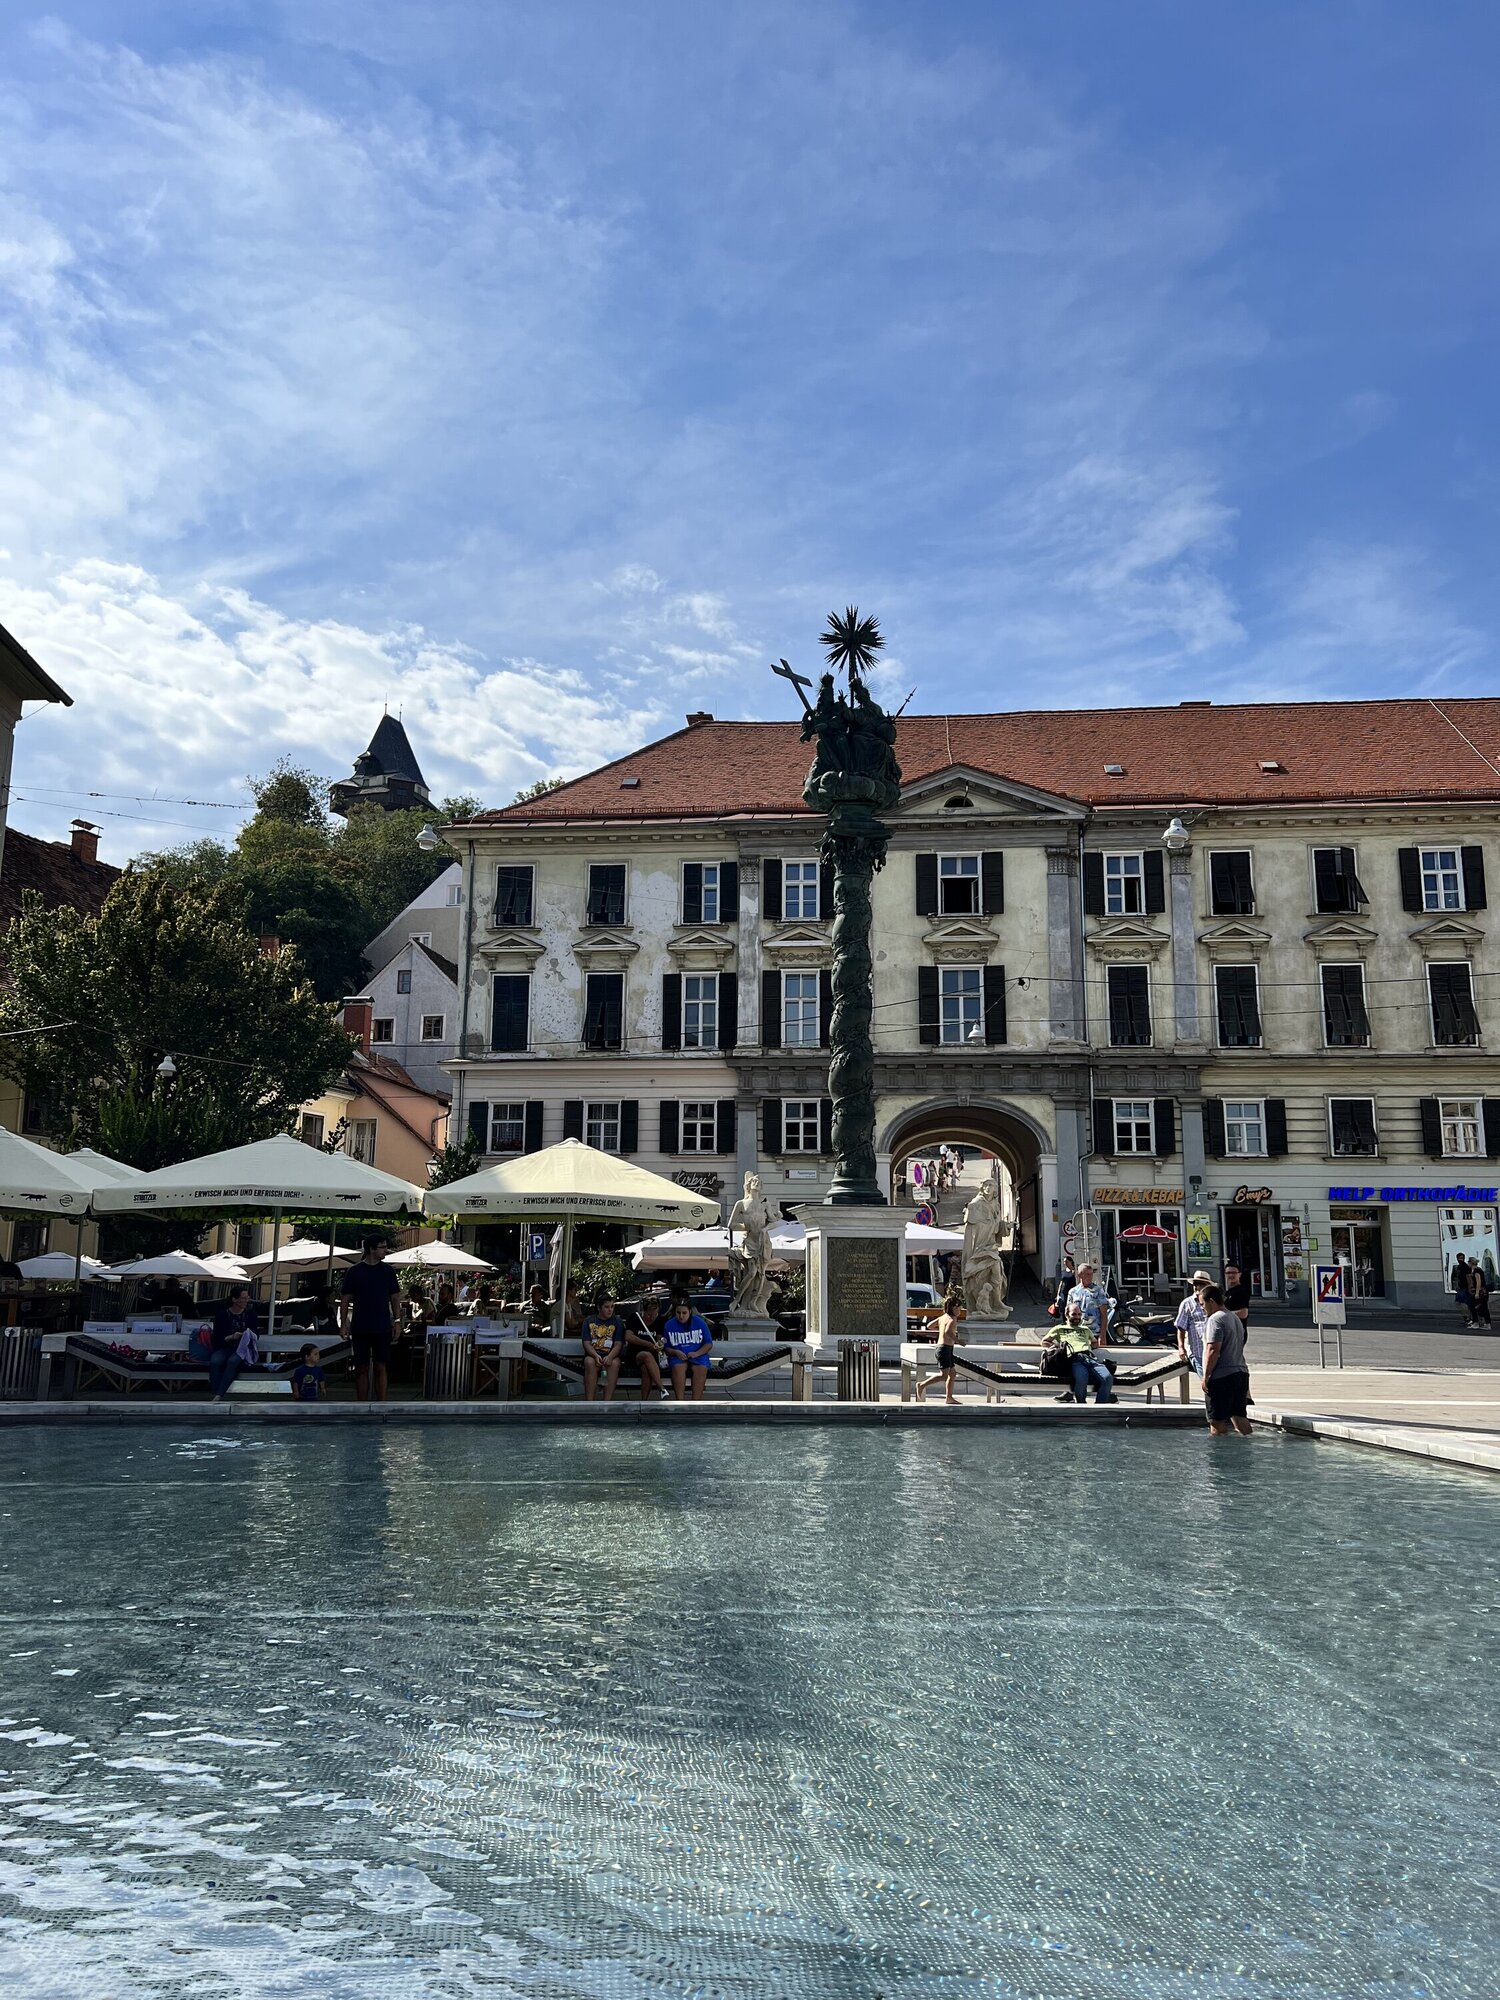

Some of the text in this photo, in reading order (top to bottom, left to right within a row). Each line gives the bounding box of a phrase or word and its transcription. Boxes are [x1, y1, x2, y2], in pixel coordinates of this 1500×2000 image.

[674, 1169, 717, 1193] Kirby's
[194, 1190, 222, 1198] ERWISCH
[223, 1189, 239, 1197] MICH
[253, 1189, 283, 1197] ERFRISCH
[283, 1190, 301, 1198] DICH!
[1094, 1188, 1132, 1203] PIZZA
[1141, 1189, 1185, 1203] KEBAP
[1328, 1185, 1499, 1202] HELP ORTHOPÄDIE
[523, 1197, 549, 1205] ERWISCH
[579, 1197, 606, 1206] ERFRISCH
[607, 1199, 623, 1207] DICH!
[532, 1235, 543, 1253] P
